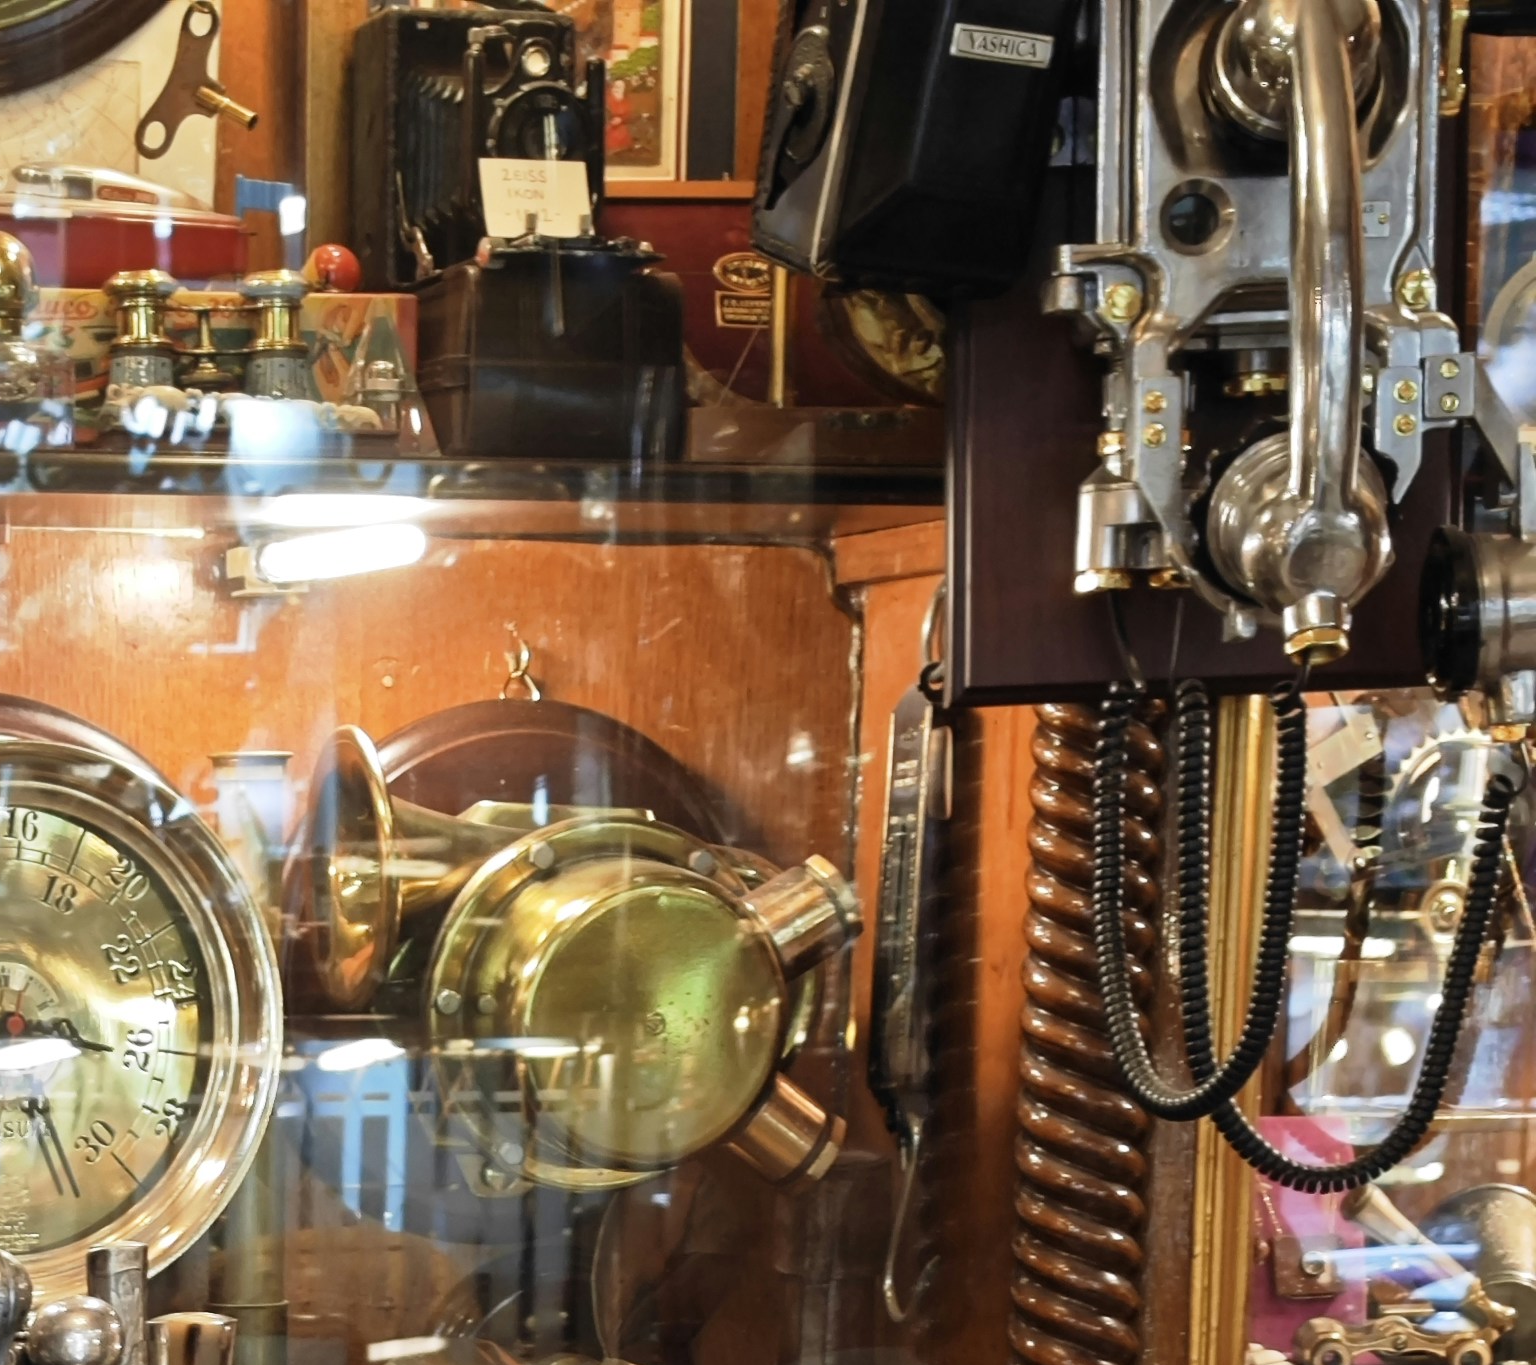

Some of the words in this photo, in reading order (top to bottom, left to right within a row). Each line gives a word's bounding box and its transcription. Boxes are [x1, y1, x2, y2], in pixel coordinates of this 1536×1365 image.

[968, 31, 1038, 59] YASHICA
[3, 807, 39, 842] 16
[40, 875, 78, 915] 18
[105, 853, 151, 902] 20
[100, 933, 143, 985] 22
[122, 1028, 154, 1073] 26
[74, 1119, 116, 1165] 30
